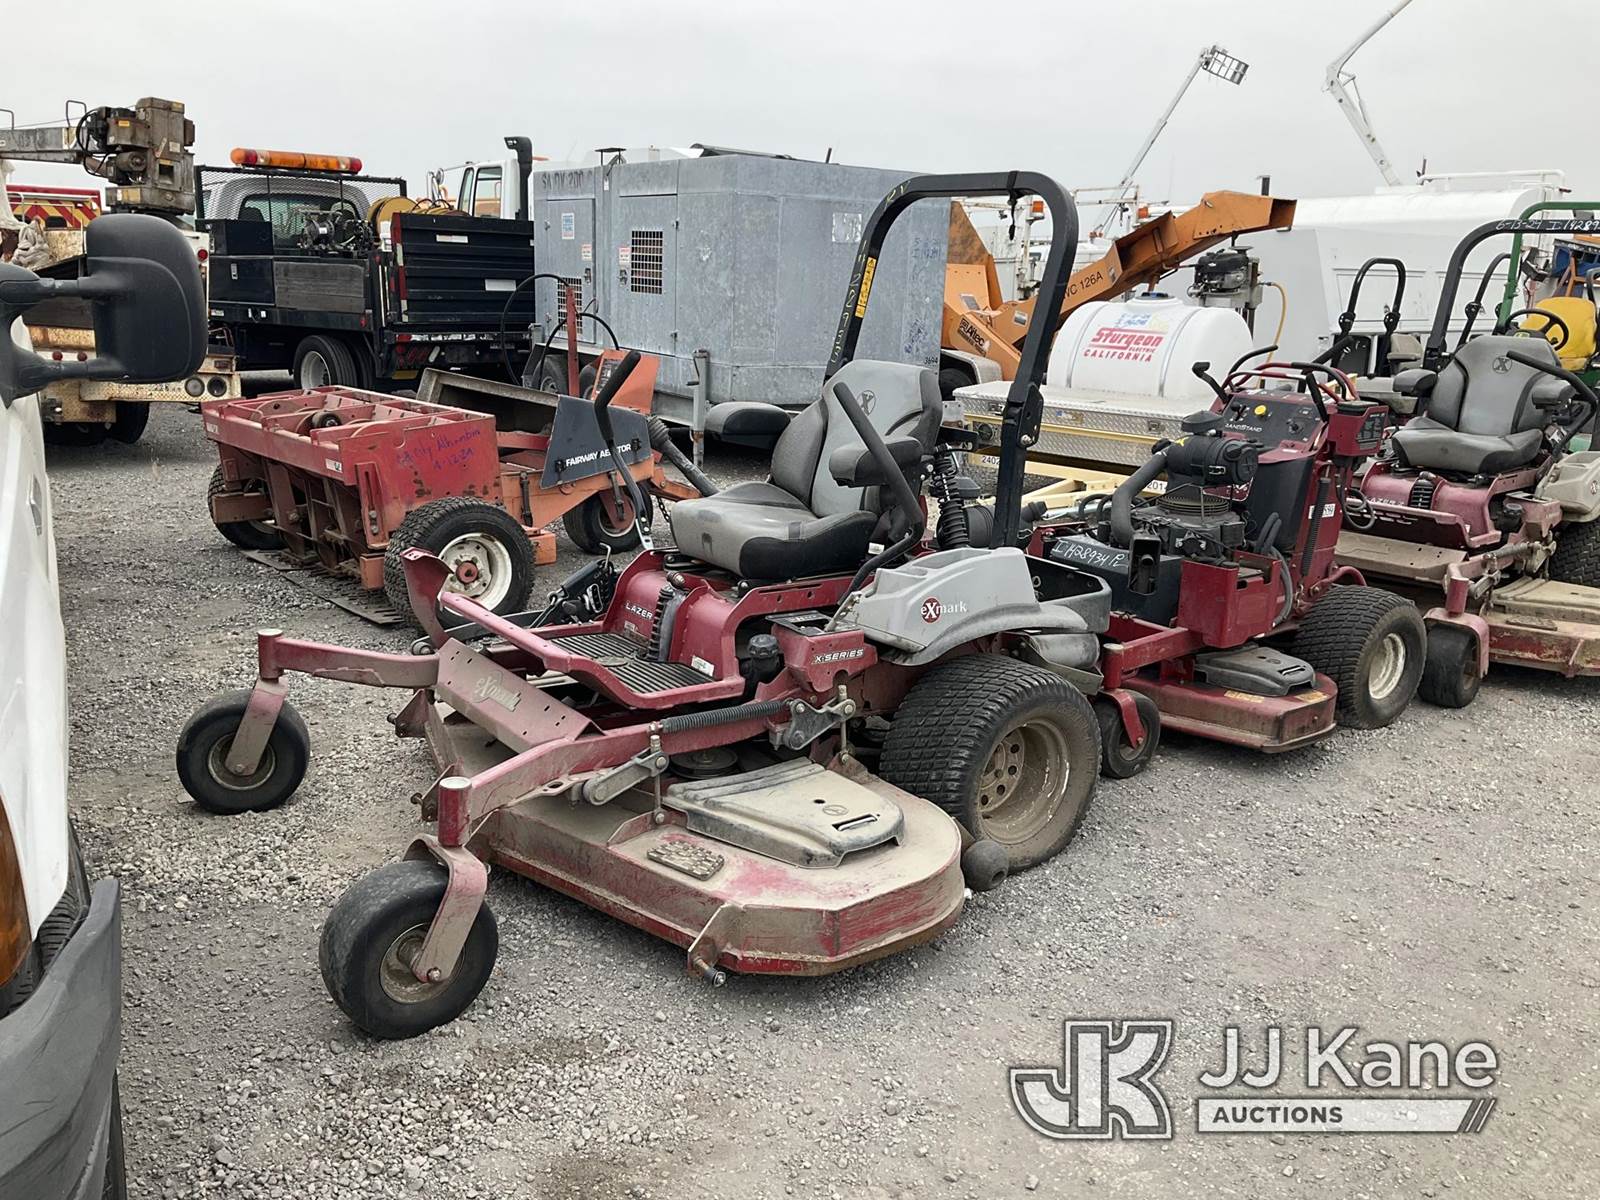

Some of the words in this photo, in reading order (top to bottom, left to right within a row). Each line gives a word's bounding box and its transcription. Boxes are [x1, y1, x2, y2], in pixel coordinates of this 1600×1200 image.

[1080, 271, 1104, 289] 126A
[1090, 328, 1165, 350] Sturgeon
[1083, 349, 1153, 362] CALIFORNIA
[565, 451, 599, 467] FAIRWAY
[599, 443, 632, 458] AETOR
[625, 603, 653, 619] LAZER
[921, 600, 968, 620] eXmark
[814, 648, 864, 663] X-SERIES
